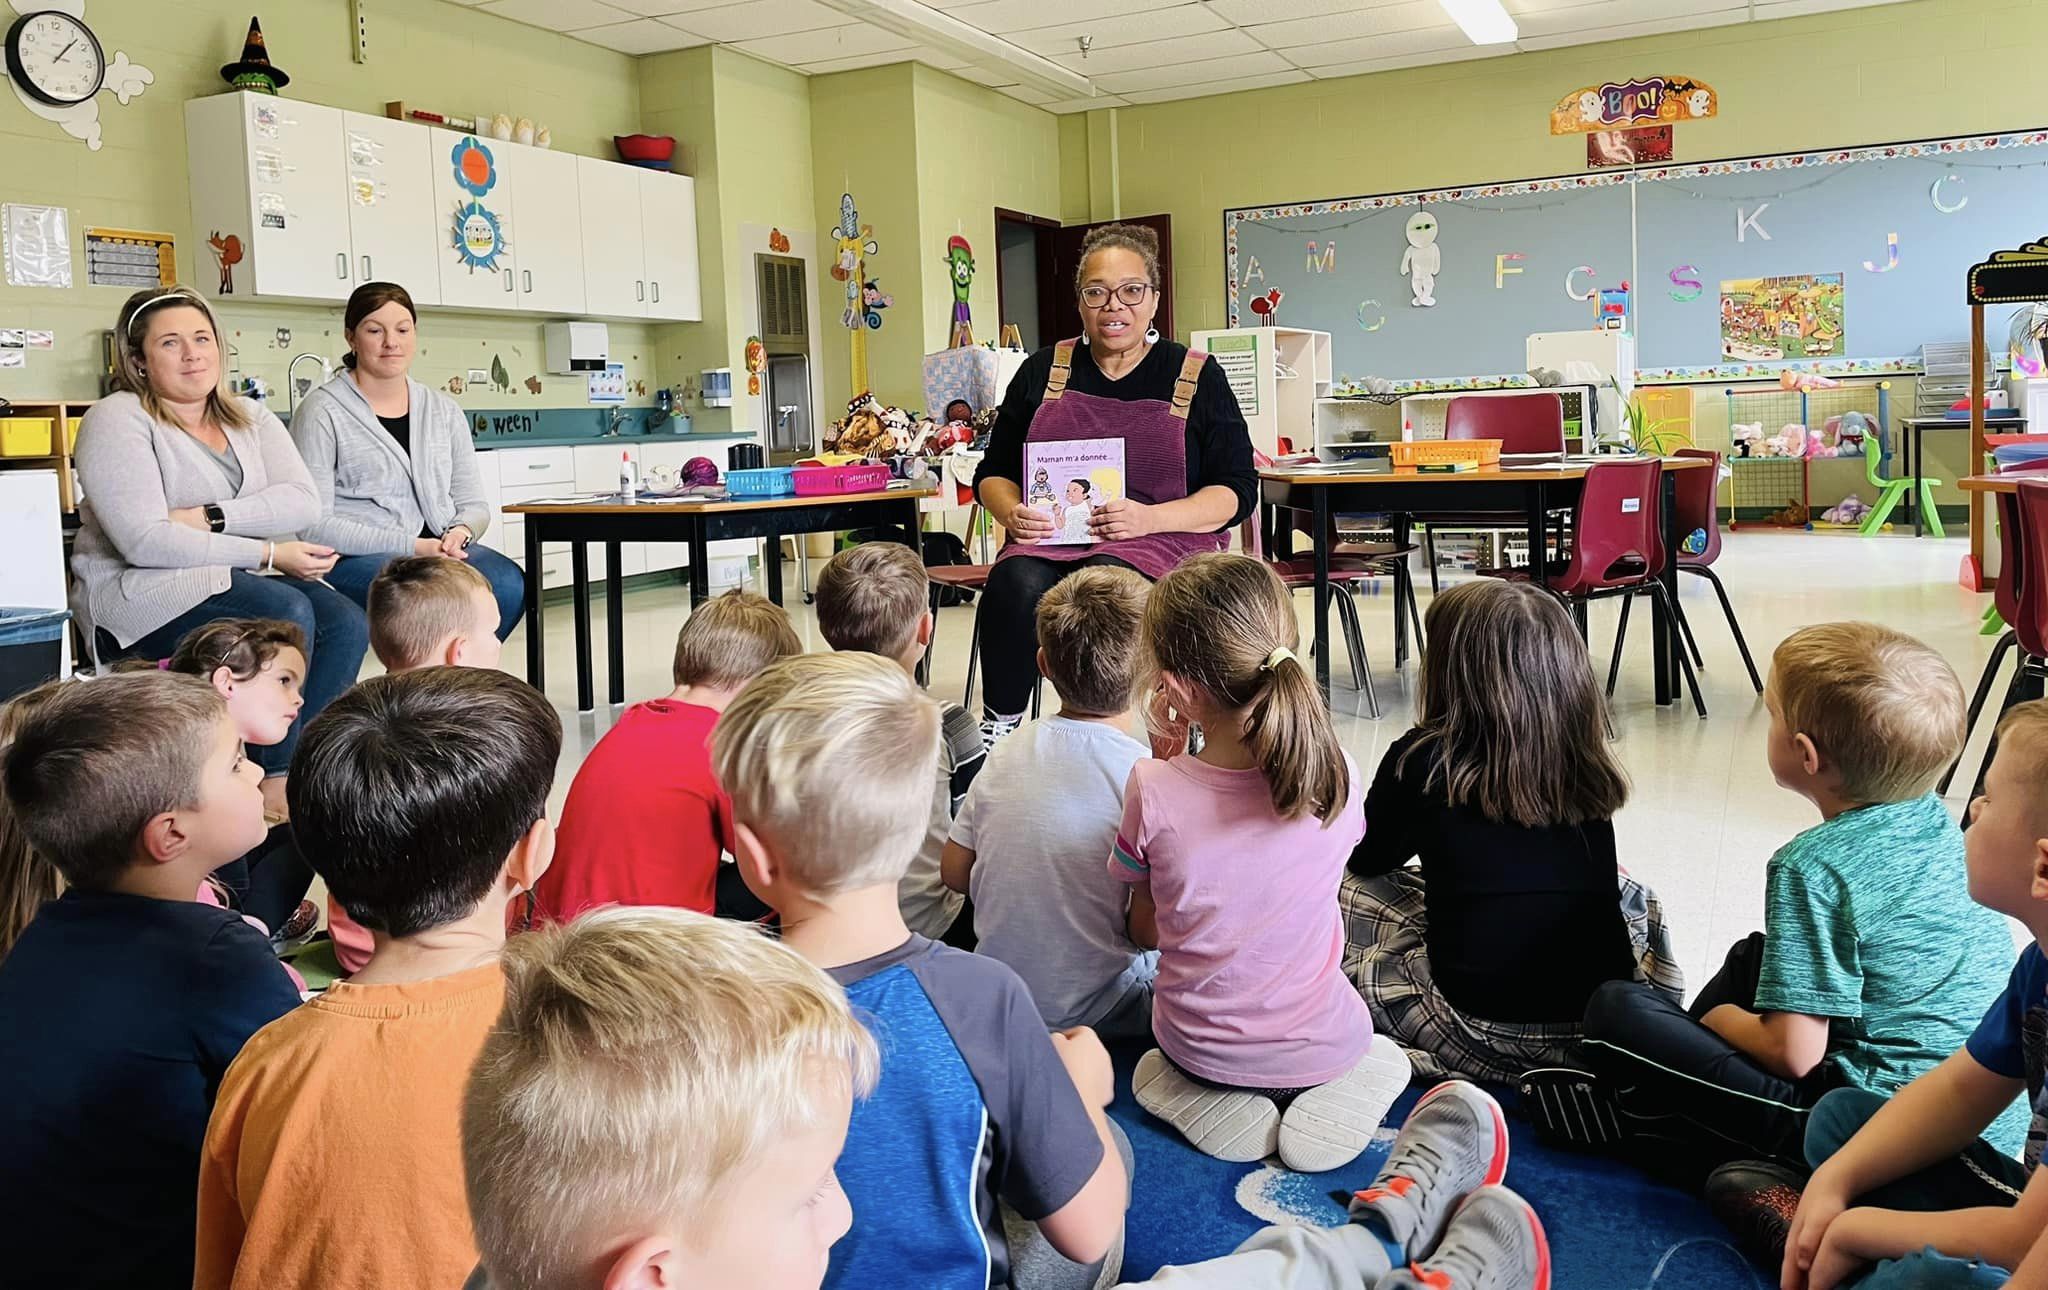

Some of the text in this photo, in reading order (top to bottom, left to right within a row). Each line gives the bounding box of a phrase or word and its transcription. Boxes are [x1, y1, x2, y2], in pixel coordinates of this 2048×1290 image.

[25, 33, 35, 42] 10
[37, 23, 45, 32] 11
[51, 21, 61, 30] 12
[80, 43, 88, 53] 2
[85, 60, 92, 69] 3
[39, 78, 46, 87] 7
[1608, 87, 1657, 116] BOO!
[1929, 174, 1969, 214] C
[1735, 203, 1772, 243] K
[1306, 240, 1336, 273] M
[1863, 232, 1899, 273] J
[1242, 255, 1265, 288] A
[1495, 254, 1527, 289] F
[1564, 265, 1597, 301] C
[1667, 264, 1704, 302] S
[1356, 299, 1385, 331] C
[1036, 456, 1064, 464] Maman
